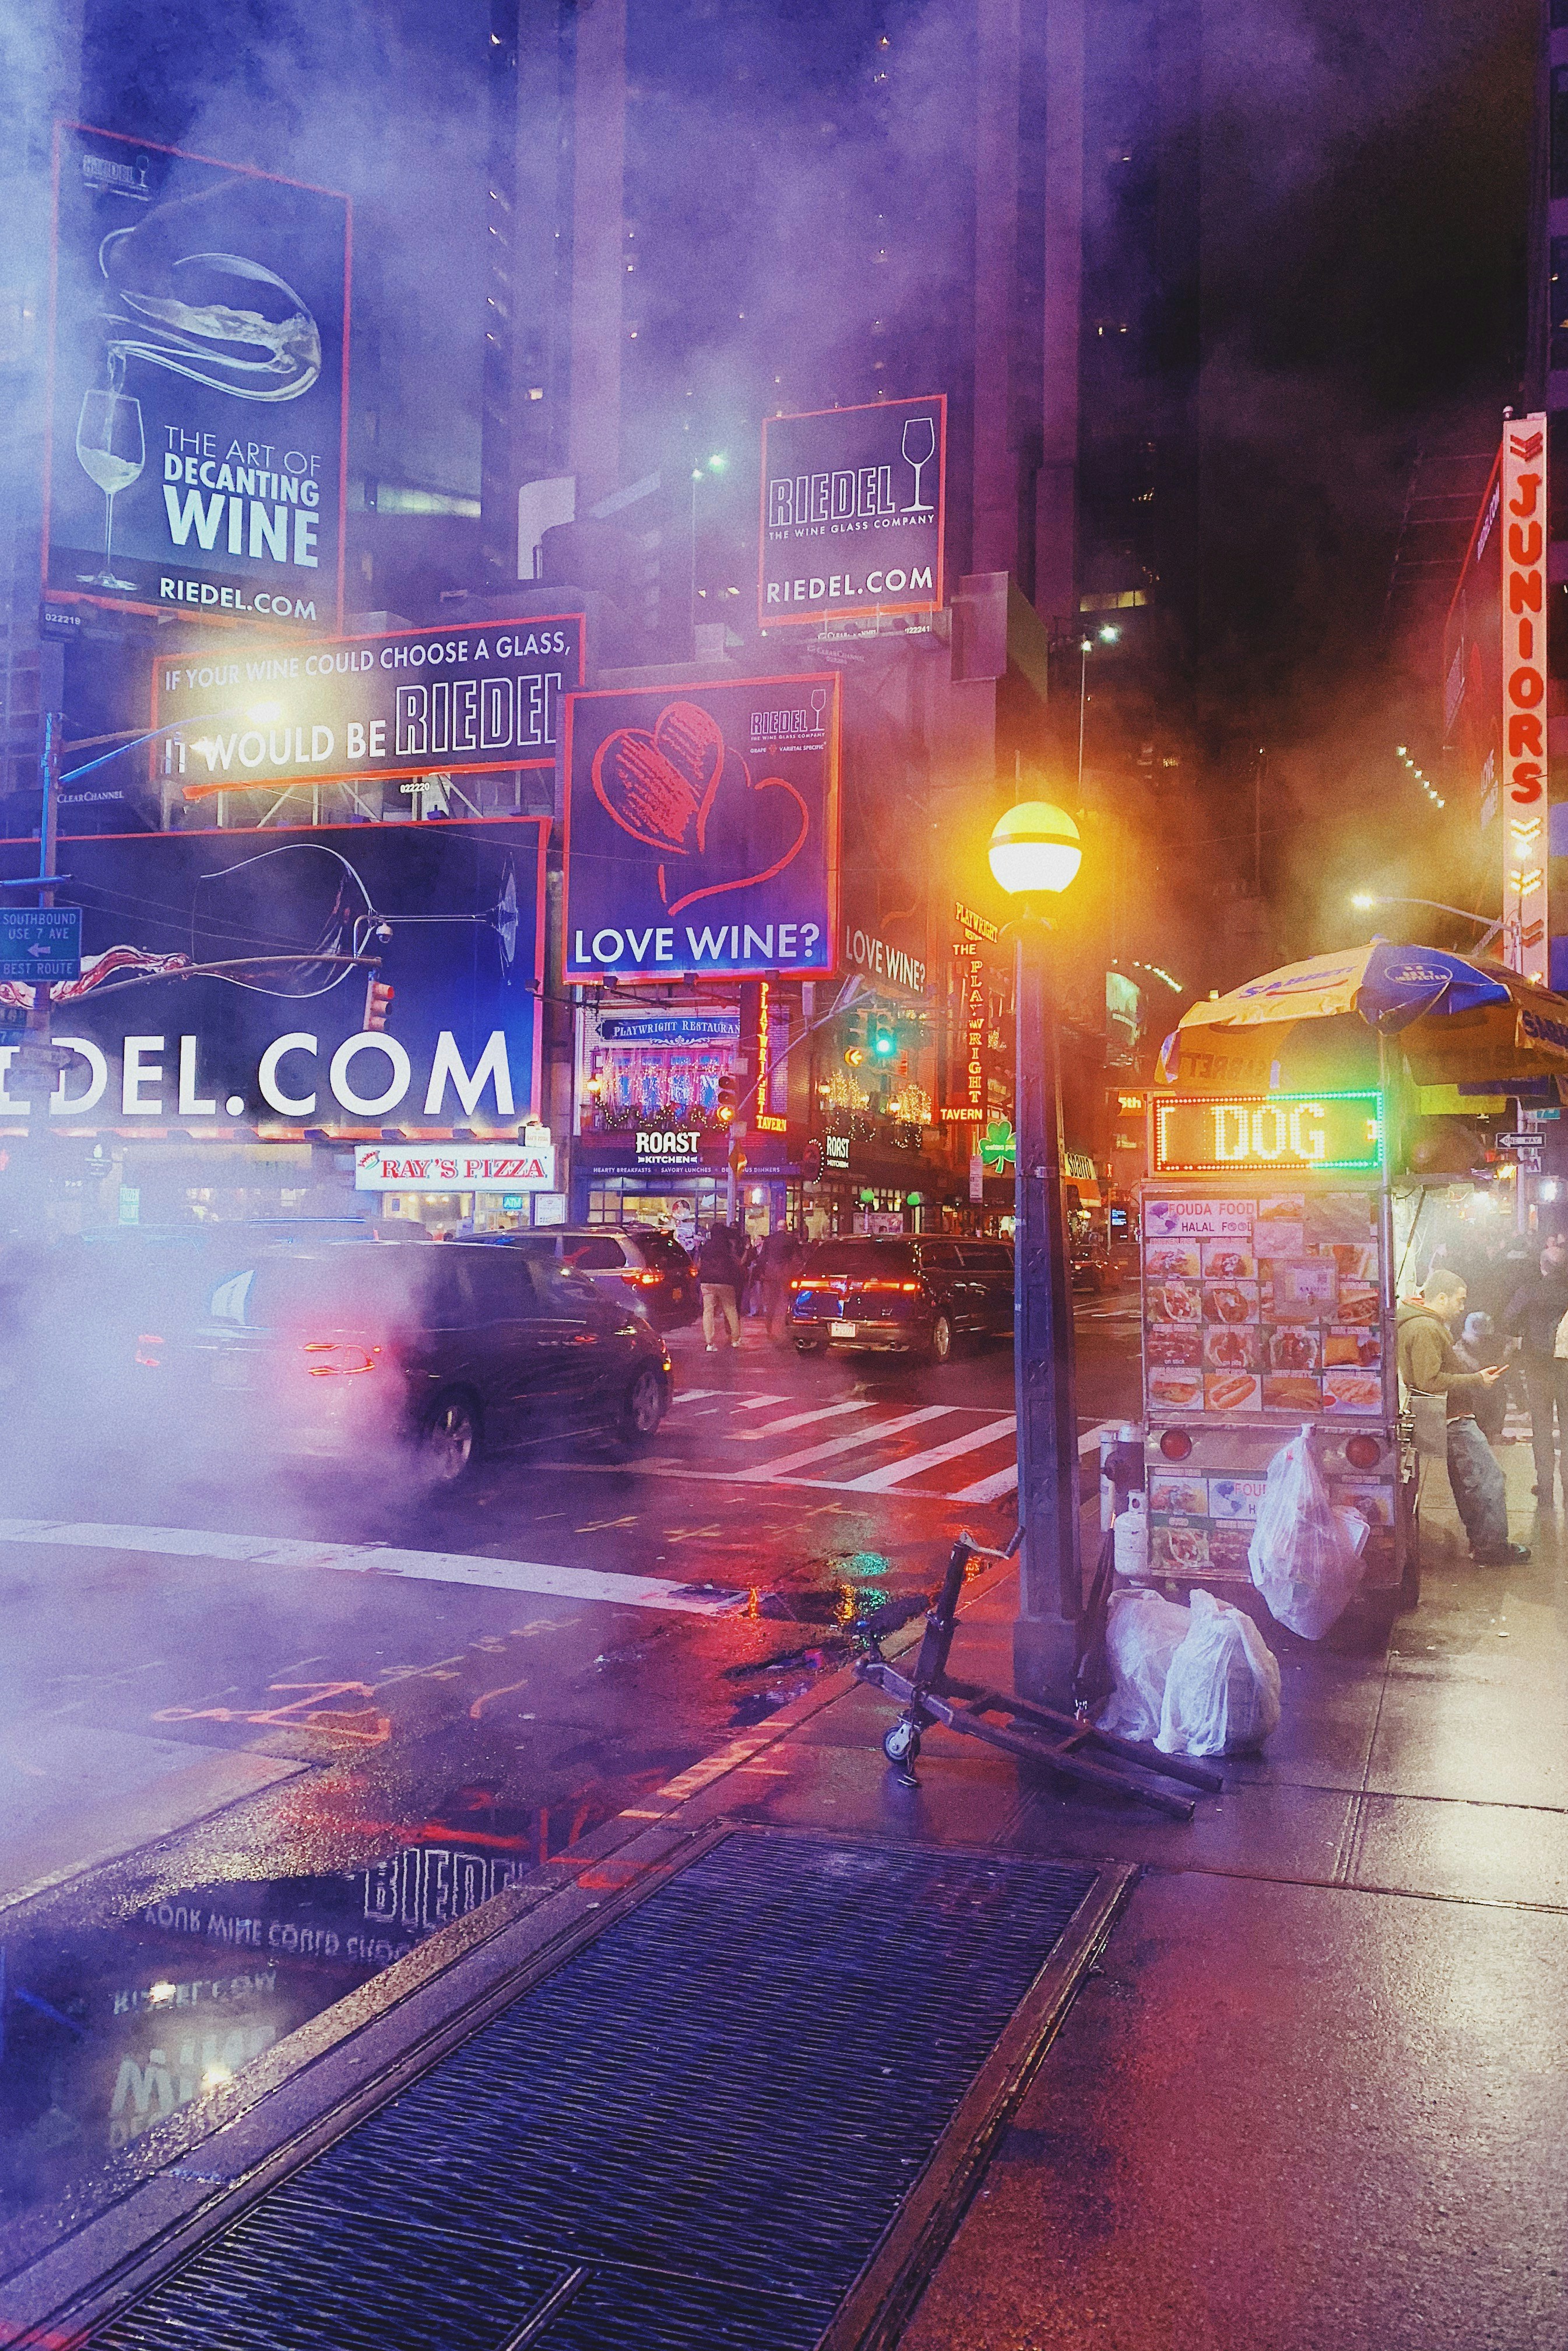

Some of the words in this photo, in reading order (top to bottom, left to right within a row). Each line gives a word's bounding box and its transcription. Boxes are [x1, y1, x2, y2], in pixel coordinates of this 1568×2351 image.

[164, 426, 216, 458] THE
[226, 439, 275, 467] ART
[284, 451, 321, 477] OF
[164, 452, 319, 507] DECANTING
[769, 465, 895, 527] RIEDEL
[163, 484, 319, 569] WINE
[769, 531, 789, 541] THE
[794, 526, 825, 538] WINE
[831, 521, 868, 534] GLASS
[874, 514, 935, 529] COMPANY
[767, 566, 933, 603] RIEDEL.COM
[160, 577, 317, 622] RIEDEL.COM
[1509, 473, 1543, 803] JUNIORS
[166, 671, 180, 691] IF
[185, 664, 240, 689] YOUR
[246, 657, 298, 683] WINE
[305, 650, 374, 676] COULD
[380, 638, 467, 671] CHOOSE
[474, 638, 490, 660] A
[495, 631, 571, 657] GLASS,
[750, 710, 808, 735] RIEDEL
[202, 725, 335, 772] WOULD
[346, 720, 386, 758] BE
[400, 781, 431, 793] 022220
[3, 913, 76, 925] SOUTHBOUND
[955, 901, 998, 943] PLAYWRIGHT
[9, 928, 30, 939] USE
[36, 928, 43, 939] 7
[49, 928, 69, 939] AVE
[575, 928, 673, 963] LOVE
[685, 923, 820, 960] WINE?
[846, 925, 883, 973] LOVE
[885, 946, 926, 992] WINE?
[952, 943, 977, 955] THE
[3, 963, 32, 974] BEST
[37, 963, 73, 974] ROUTE
[613, 1022, 677, 1037] PLAYWRIGHT
[969, 960, 985, 1103] PLAYWRIGHT
[757, 1115, 786, 1131] TAVERN
[940, 1108, 983, 1120] TAVERN
[635, 1131, 701, 1153] ROAST
[1211, 1103, 1325, 1160] DOG
[827, 1136, 849, 1159] ROAST
[380, 1158, 459, 1179] RAY'S
[463, 1158, 547, 1178] PIZZA
[830, 1160, 846, 1168] KITCHEN
[505, 1197, 521, 1208] ATM
[1169, 1203, 1212, 1216] FOUDA
[1219, 1203, 1254, 1215] FOOD
[1182, 1222, 1214, 1231] HALAL
[1222, 1222, 1253, 1231] FOOD
